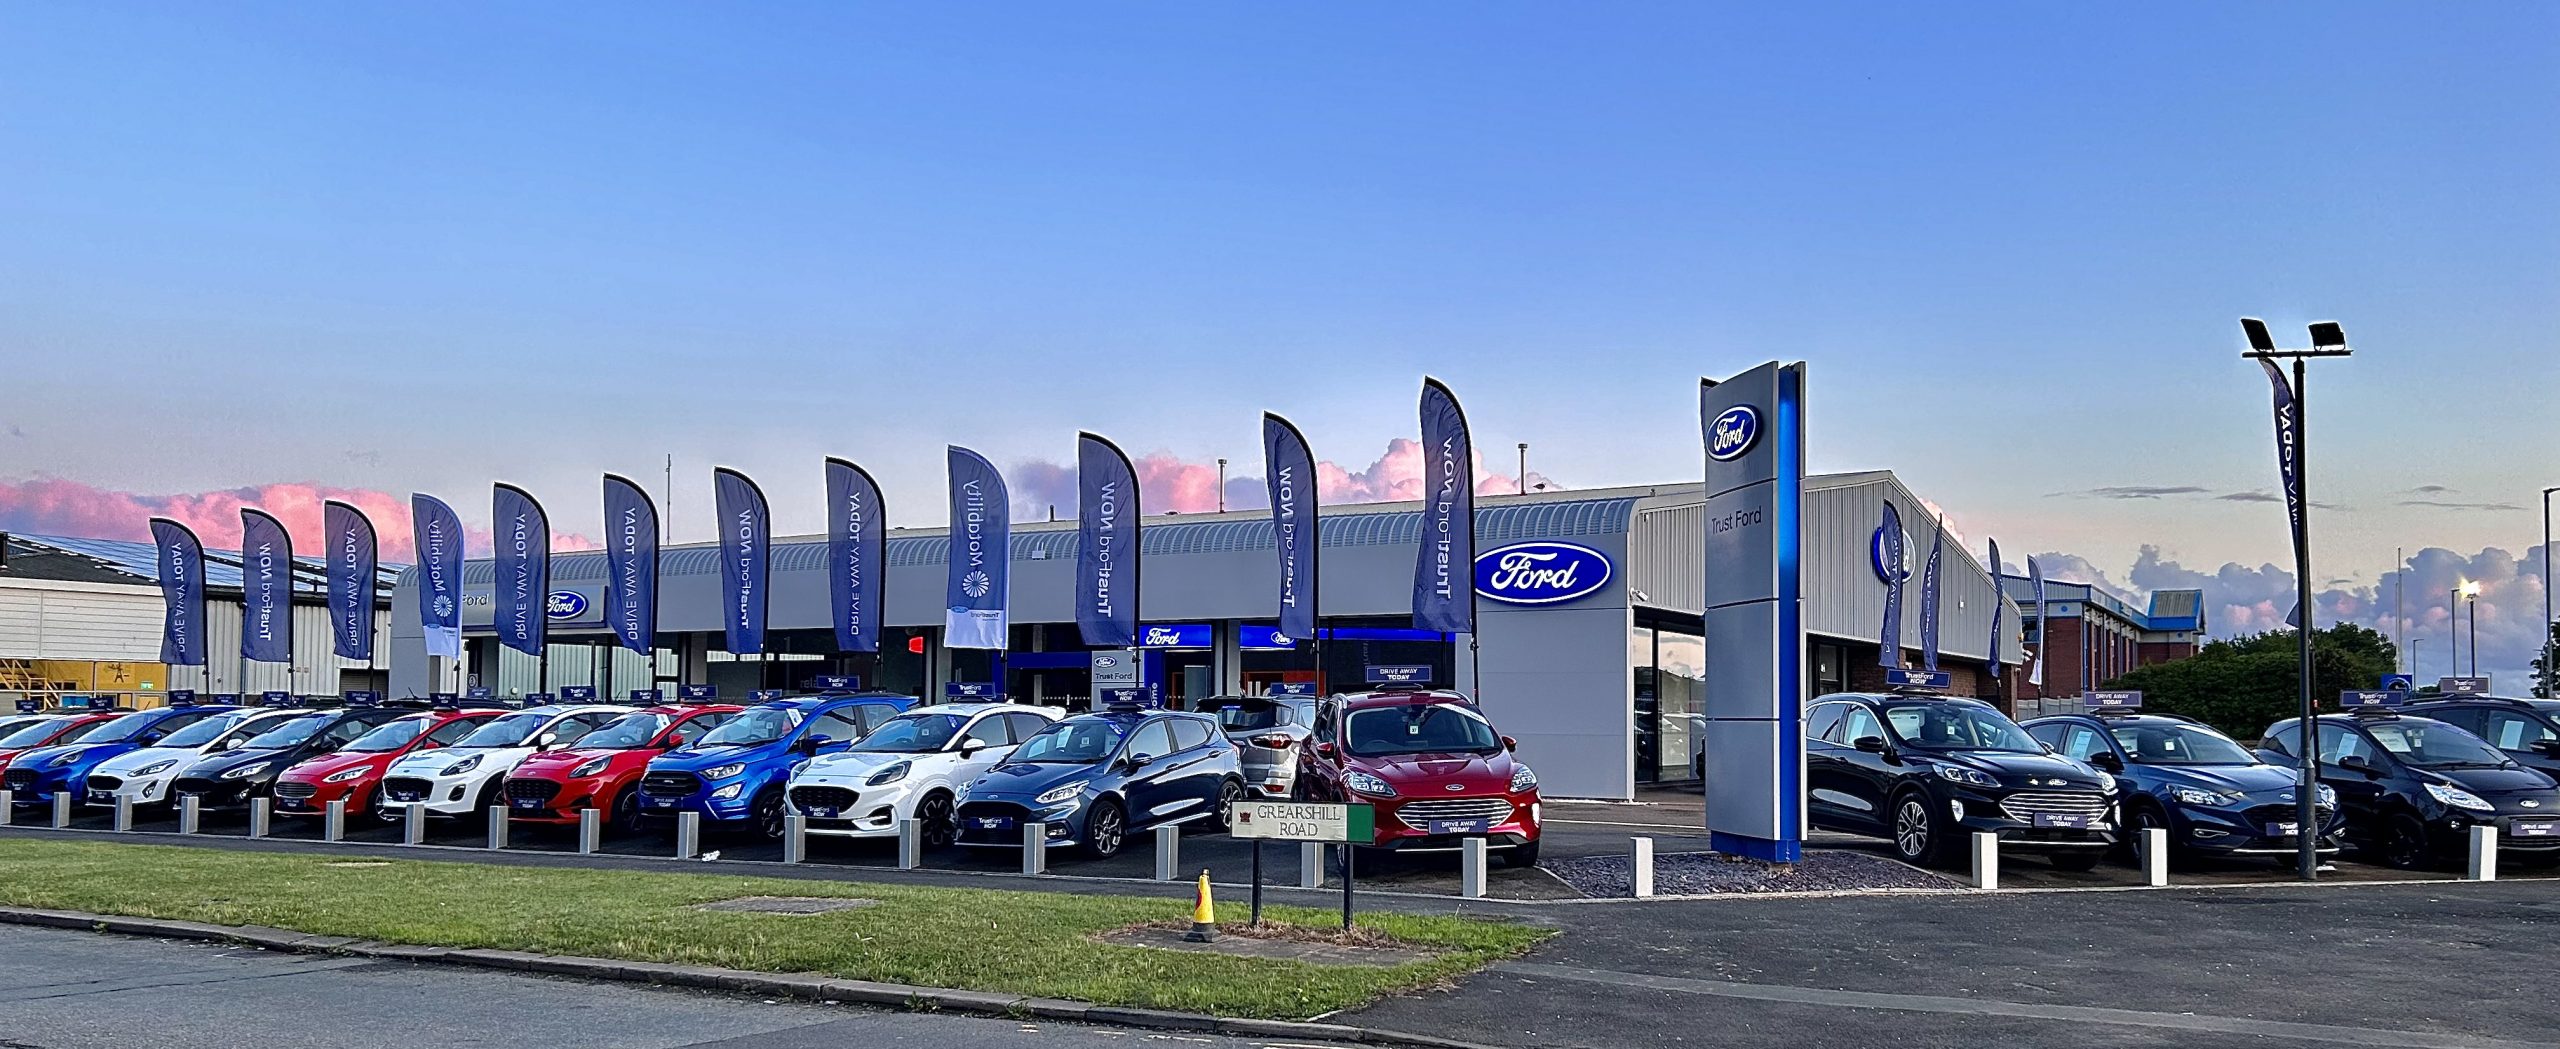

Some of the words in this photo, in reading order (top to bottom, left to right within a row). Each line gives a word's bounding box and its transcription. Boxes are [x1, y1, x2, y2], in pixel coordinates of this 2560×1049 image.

[1714, 415, 1745, 451] Ford
[1711, 514, 1733, 535] Trust
[1735, 506, 1762, 528] Ford
[1491, 552, 1579, 589] Ford
[548, 595, 576, 612] Ford
[1146, 628, 1180, 645] Ford
[1114, 672, 1133, 680] Ford
[1904, 672, 1935, 680] TrustFord
[2358, 692, 2388, 700] TrustFord
[1257, 804, 1341, 821] GREARSHILL
[1279, 821, 1319, 837] ROAD
